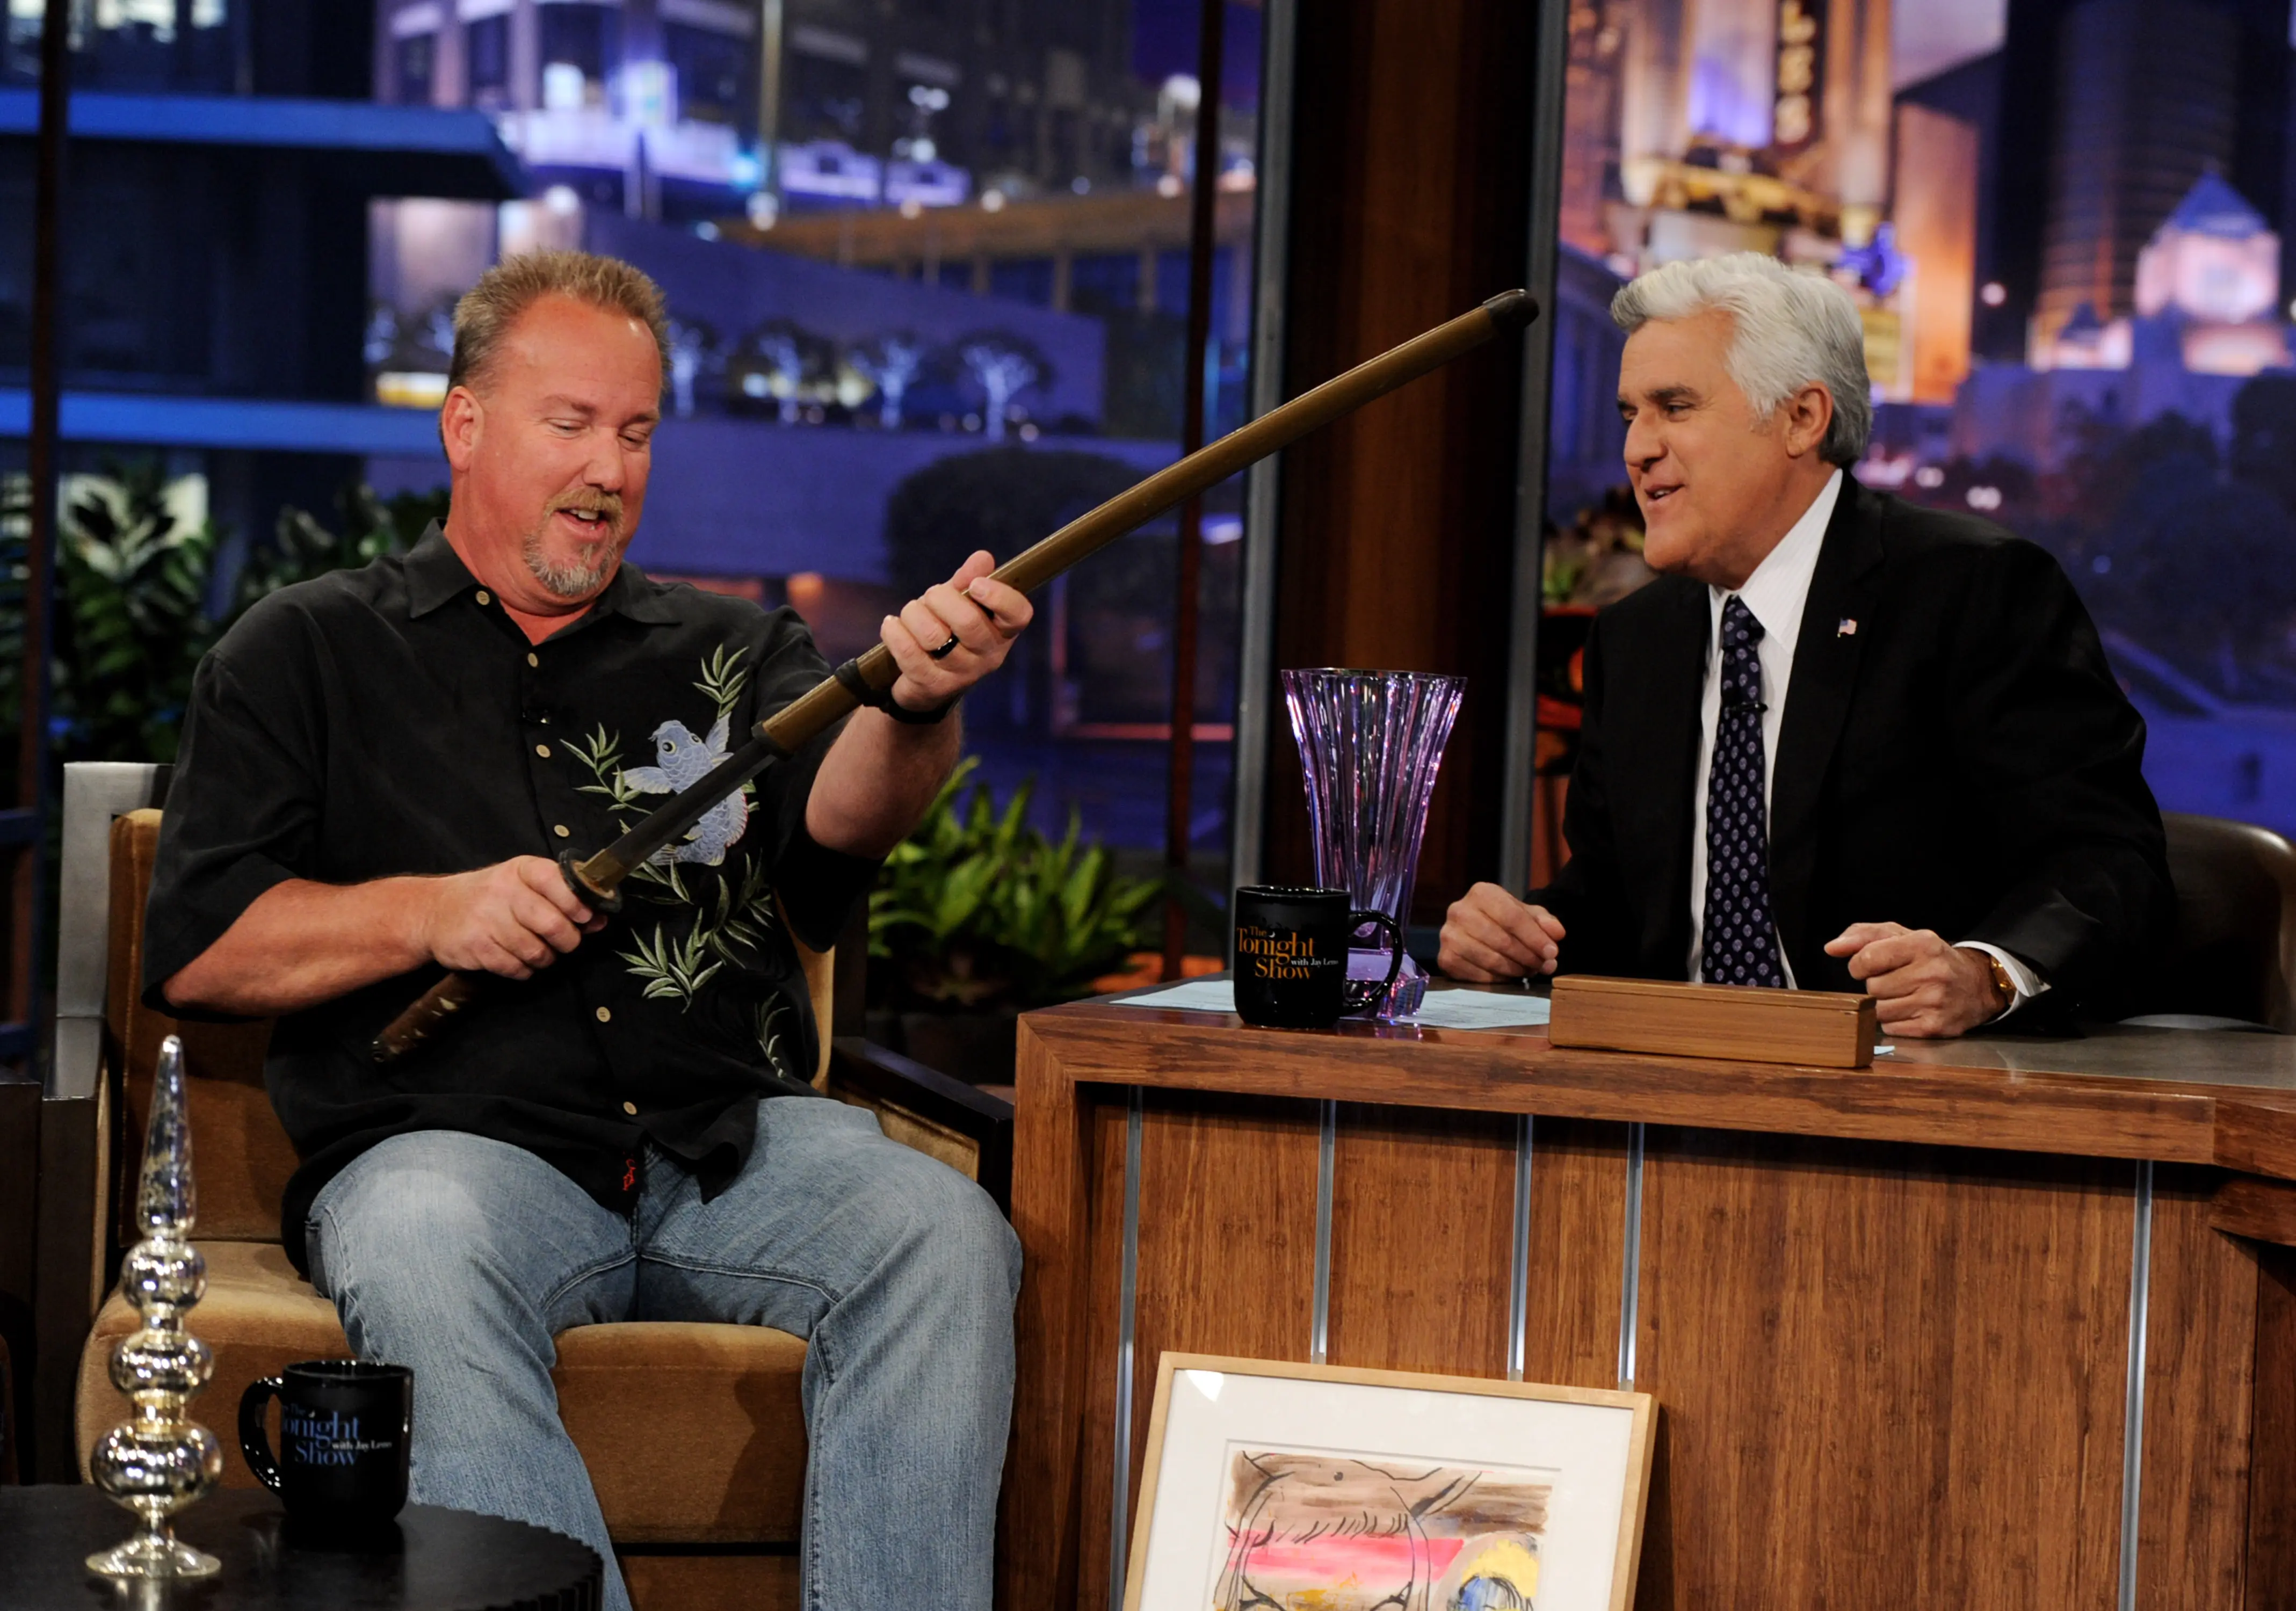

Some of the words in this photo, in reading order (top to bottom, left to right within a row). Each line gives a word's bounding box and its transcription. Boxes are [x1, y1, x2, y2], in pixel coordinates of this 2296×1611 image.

[1249, 925, 1267, 937] The
[1237, 927, 1316, 965] Tonight
[1254, 956, 1313, 979] Show
[1291, 957, 1309, 966] with
[1310, 957, 1322, 968] Jay
[295, 1440, 359, 1466] Show
[331, 1440, 353, 1450] with
